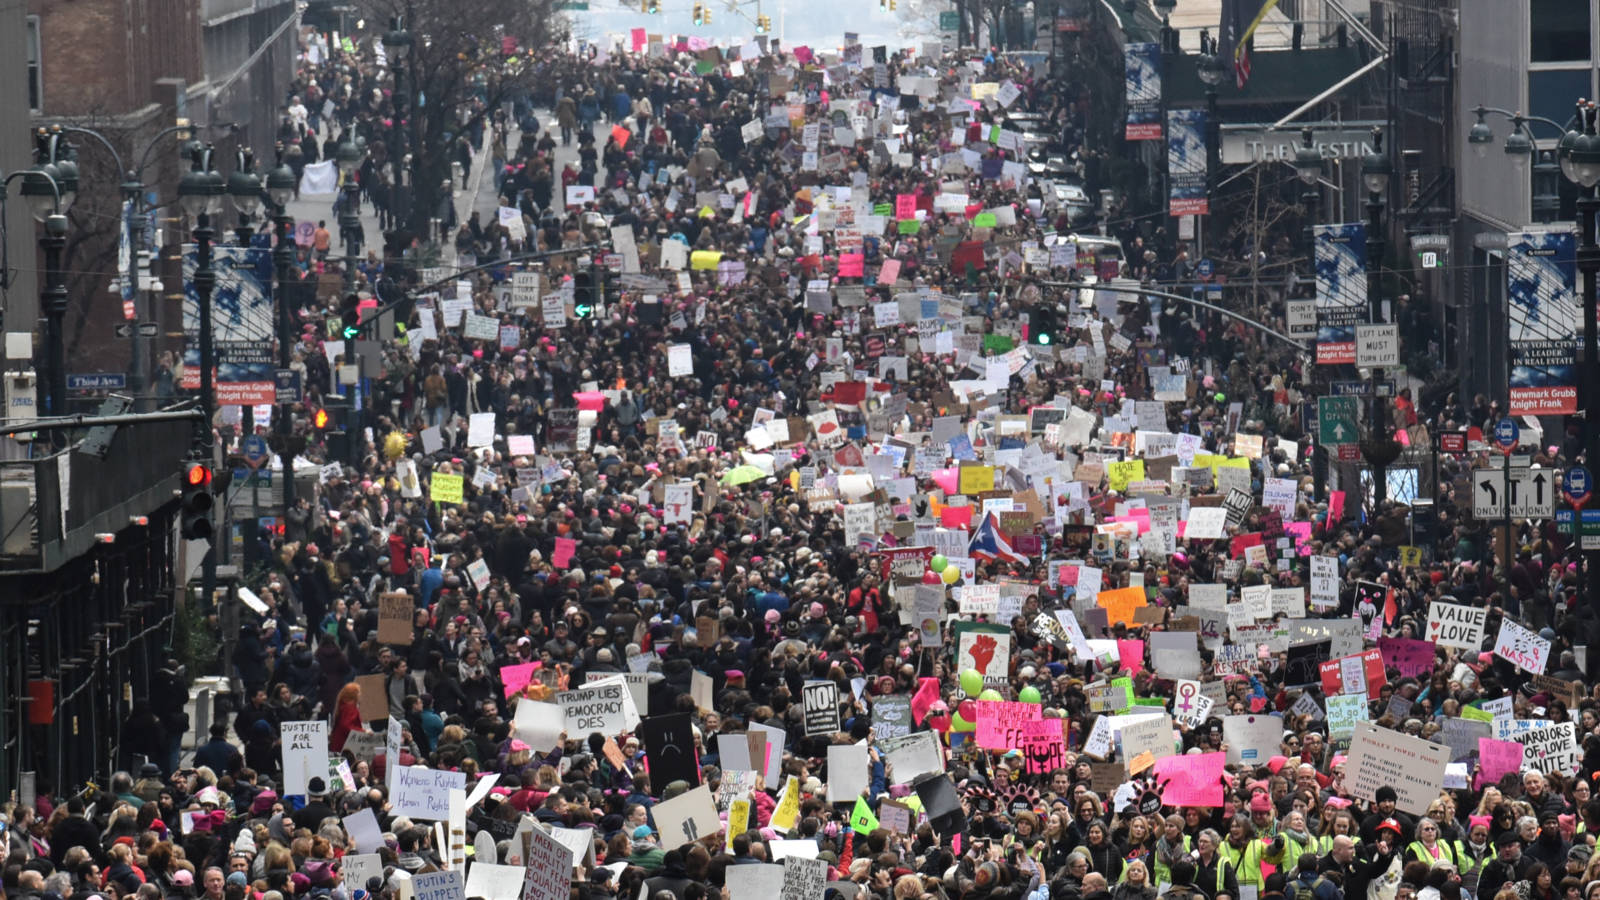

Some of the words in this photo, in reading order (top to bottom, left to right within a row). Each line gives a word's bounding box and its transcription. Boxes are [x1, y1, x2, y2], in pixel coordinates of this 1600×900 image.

[1359, 330, 1376, 338] LEFT
[1378, 329, 1394, 337] LANE
[1366, 341, 1388, 350] MUST
[1511, 341, 1530, 349] NEW
[1531, 341, 1552, 349] YORK
[1360, 354, 1377, 362] TURN
[1379, 353, 1396, 361] LEFT
[74, 376, 100, 386] Third
[102, 377, 119, 386] Ave
[217, 384, 250, 392] Newmark
[252, 383, 274, 391] Grubb
[1337, 383, 1365, 394] Third
[217, 392, 241, 401] Knight
[243, 391, 264, 400] Frank
[1511, 390, 1549, 399] Newmark
[1551, 389, 1577, 398] Grubb
[1511, 400, 1537, 410] Knight
[1540, 399, 1562, 408] Frank
[700, 433, 715, 447] NO
[1226, 488, 1252, 512] NO!
[1476, 506, 1498, 515] ONLY
[1528, 506, 1551, 515] ONLY
[1437, 605, 1485, 626] VALUE
[1440, 624, 1478, 643] LOVE
[1215, 660, 1249, 675] RESPECT
[560, 689, 595, 704] TRUMP
[597, 687, 620, 700] LIES
[804, 685, 835, 712] NO!
[1327, 698, 1340, 708] We
[1344, 697, 1358, 706] will
[1328, 708, 1343, 719] not
[1347, 711, 1359, 720] go
[281, 723, 321, 733] JUSTICE
[577, 716, 605, 730] DIES
[1499, 720, 1509, 728] IF
[1516, 720, 1530, 728] YOU
[293, 733, 310, 742] FOR
[1005, 728, 1024, 747] FE
[1514, 725, 1572, 745] WARRIORS
[290, 741, 313, 750] ALL
[1525, 745, 1540, 759] OF
[1545, 739, 1571, 755] LOVE
[1529, 752, 1574, 774] NITE!
[535, 834, 553, 851] MEN
[556, 847, 567, 860] OF
[531, 847, 566, 872] QUALITY
[416, 873, 455, 889] PUTIN'S
[527, 868, 568, 899] EQUALITY
[550, 869, 570, 887] FEAR
[418, 887, 460, 900] PUPPET
[530, 886, 545, 898] NOT
